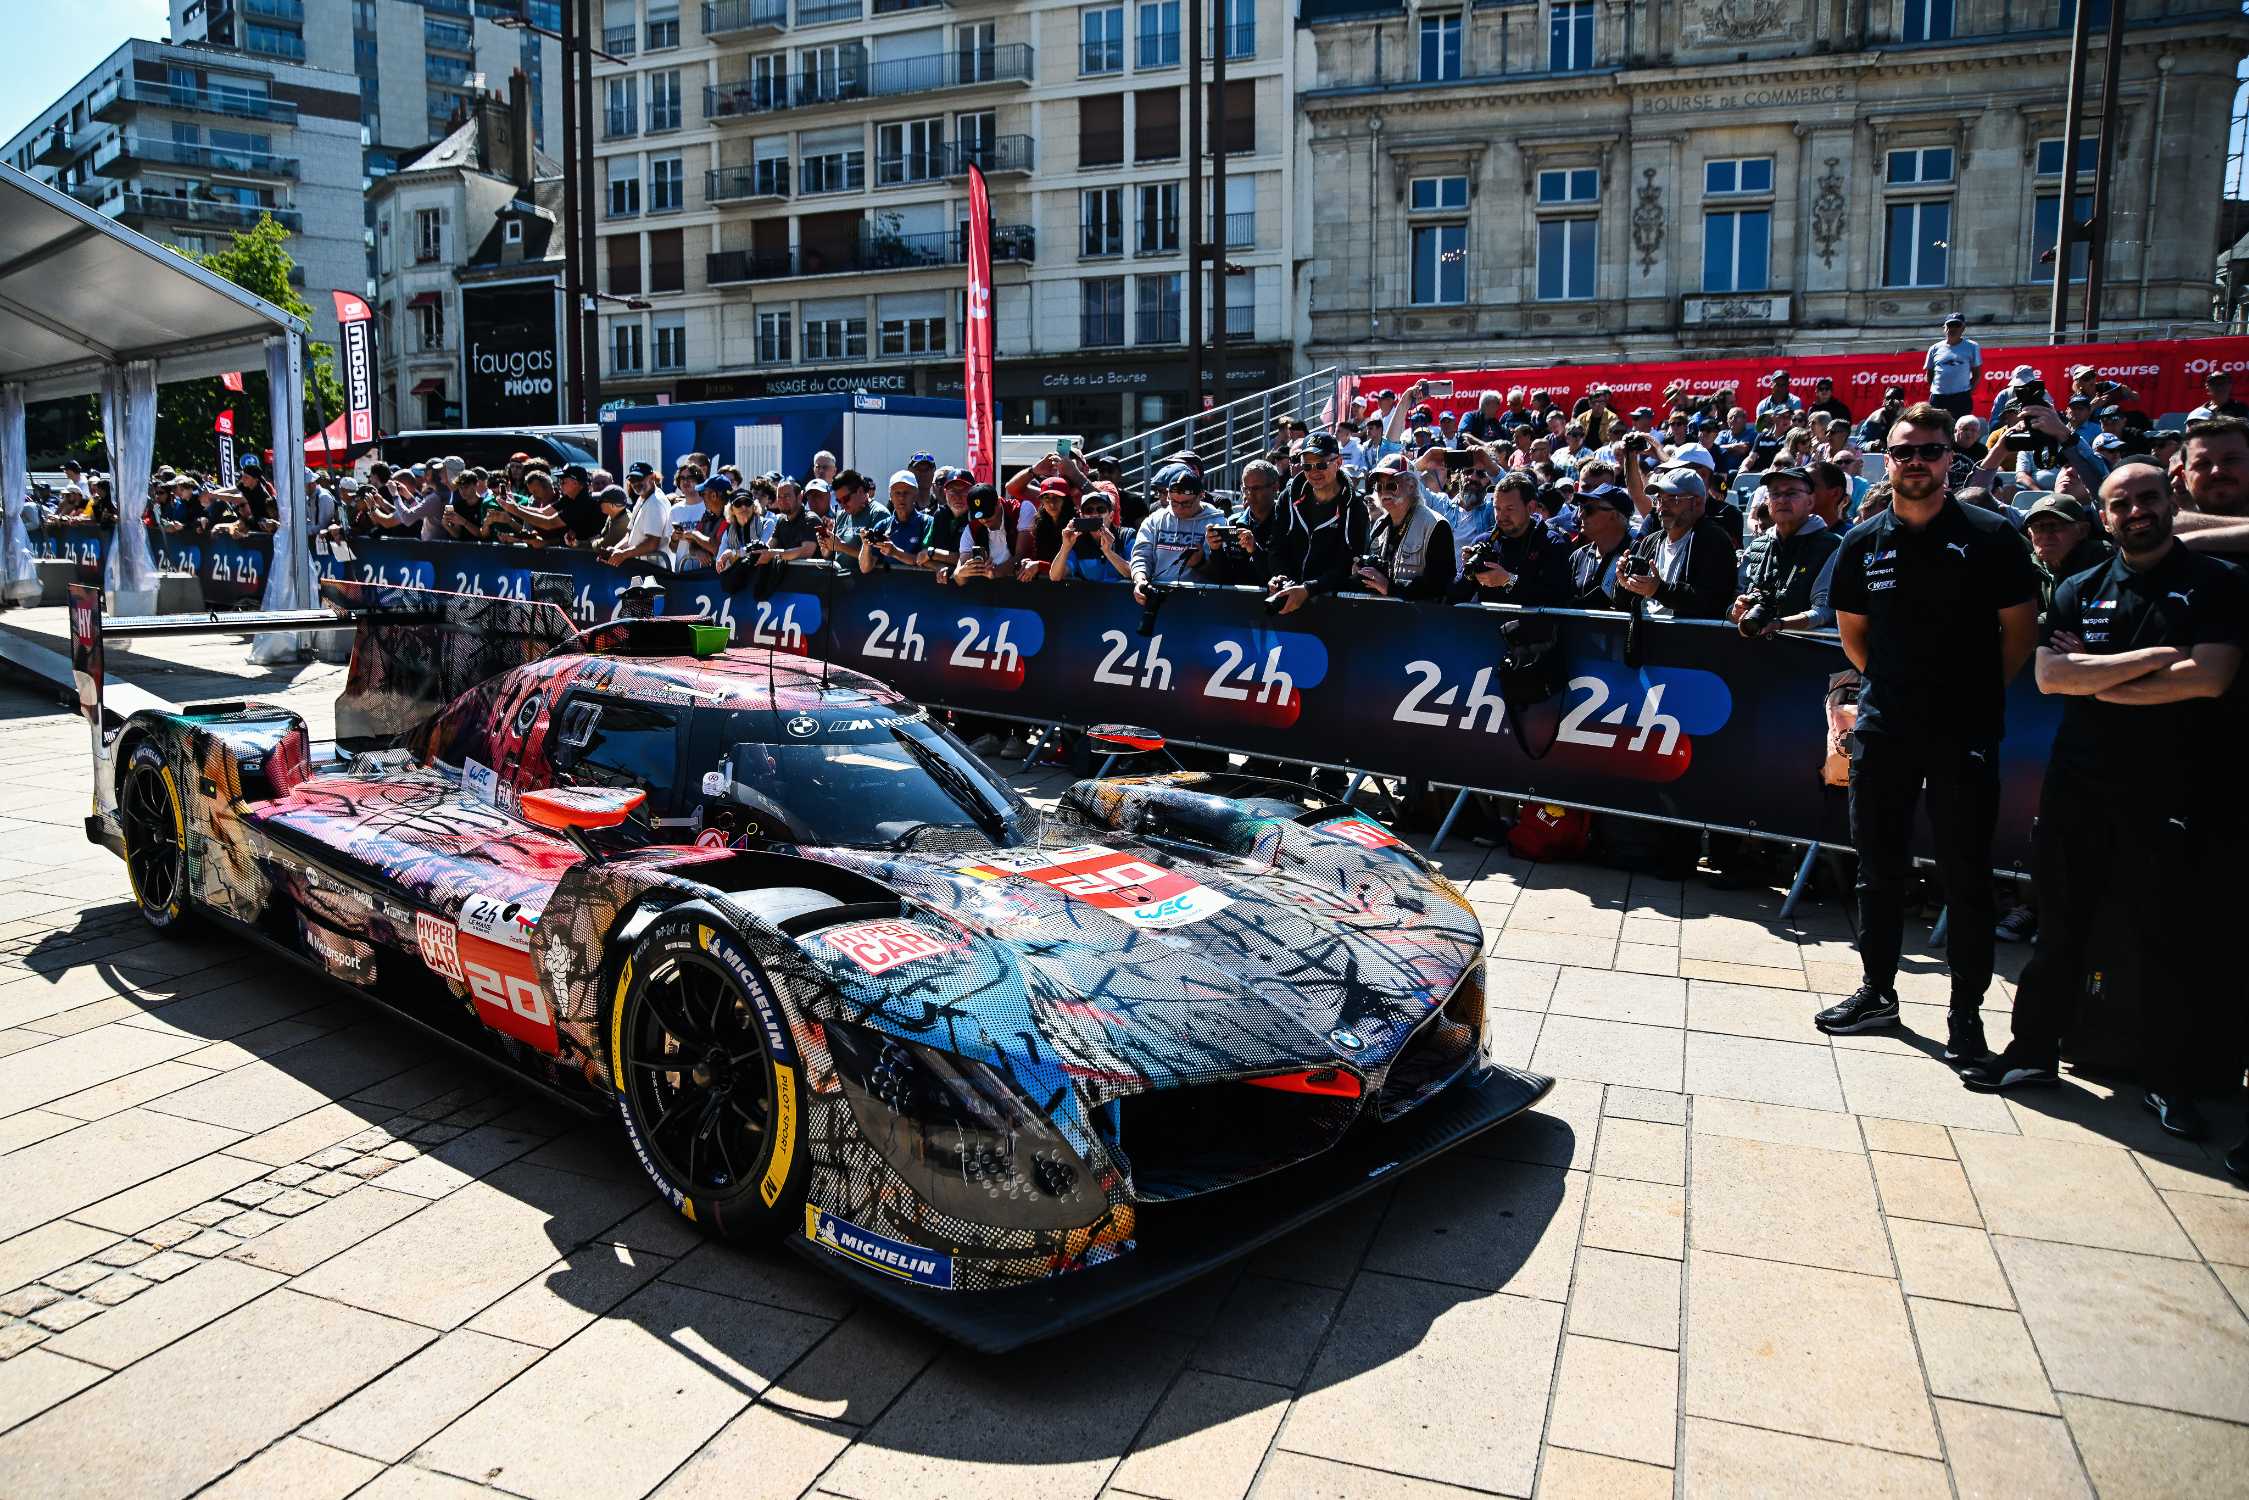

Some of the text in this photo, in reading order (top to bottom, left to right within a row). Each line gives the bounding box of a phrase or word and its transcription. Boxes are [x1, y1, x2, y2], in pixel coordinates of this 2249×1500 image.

[1643, 85, 1845, 113] BOURSE DE COMMERCE
[472, 343, 553, 378] faugas
[2098, 363, 2160, 377] course
[2184, 358, 2217, 374] :Of
[504, 378, 553, 397] PHOTO
[767, 375, 905, 393] PASSAGE du COMMERCE
[1043, 373, 1070, 387] Café
[1073, 374, 1086, 385] de
[1107, 371, 1148, 384] Bourse
[1610, 382, 1653, 394] course
[1694, 378, 1740, 390] course
[1852, 371, 1877, 385] :Of
[82, 543, 97, 567] 24h
[212, 553, 231, 582] 24h
[236, 555, 257, 584] 24h
[76, 608, 91, 638] HY
[754, 601, 801, 649] 24h
[861, 609, 926, 662] 24h
[949, 616, 1019, 673] 24h
[1093, 629, 1173, 691] 24h
[1203, 640, 1294, 706] 24h
[1392, 660, 1506, 735] 24h
[1556, 675, 1681, 756] 24h
[1046, 861, 1170, 896] 20
[470, 900, 500, 924] 24h
[1134, 895, 1194, 919] WEC
[418, 916, 454, 947] HYPER
[831, 922, 912, 950] HYPER
[421, 937, 463, 979] CAR
[852, 931, 938, 968] CAR
[464, 960, 551, 1026] 20
[722, 946, 786, 1052] MICHELIN
[764, 1179, 779, 1201] M
[839, 1231, 937, 1276] MICHELIN
